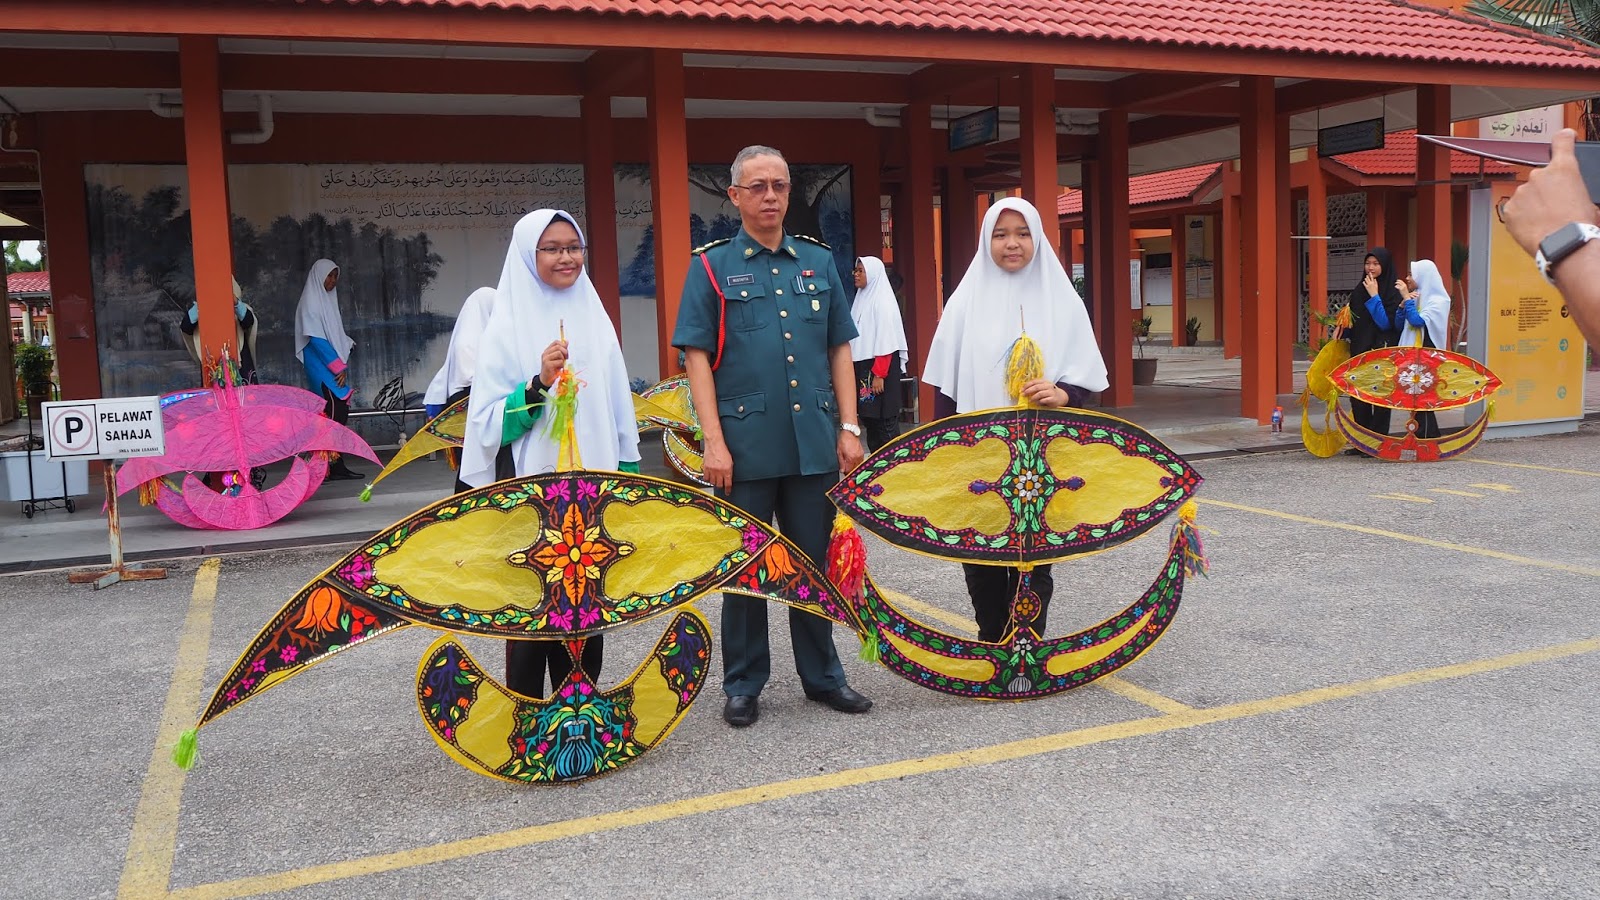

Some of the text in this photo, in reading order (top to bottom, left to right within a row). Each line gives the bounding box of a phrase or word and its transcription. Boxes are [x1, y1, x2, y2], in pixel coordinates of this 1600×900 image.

[100, 410, 153, 423] PELAWAT
[65, 417, 84, 444] P
[105, 429, 152, 441] SAHAJA
